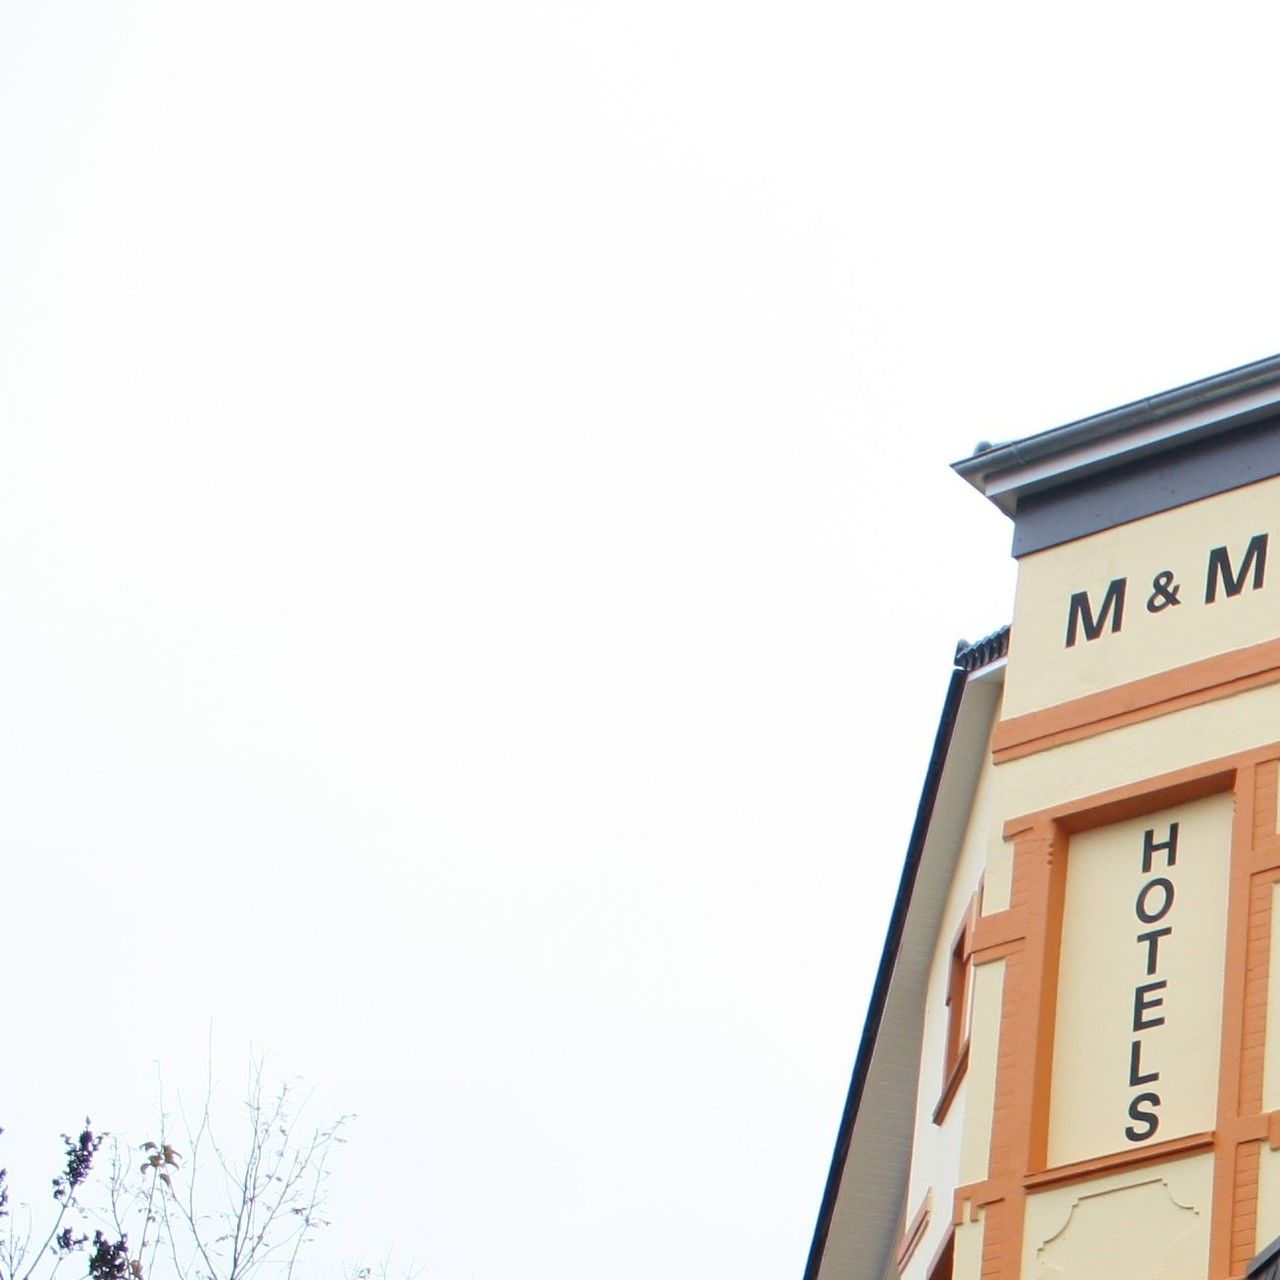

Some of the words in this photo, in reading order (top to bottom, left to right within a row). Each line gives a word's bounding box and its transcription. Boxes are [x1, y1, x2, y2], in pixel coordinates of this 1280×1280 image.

[1065, 577, 1126, 647] M
[1147, 570, 1183, 613] &
[1205, 533, 1268, 604] M
[1126, 822, 1179, 1142] HOTELS
